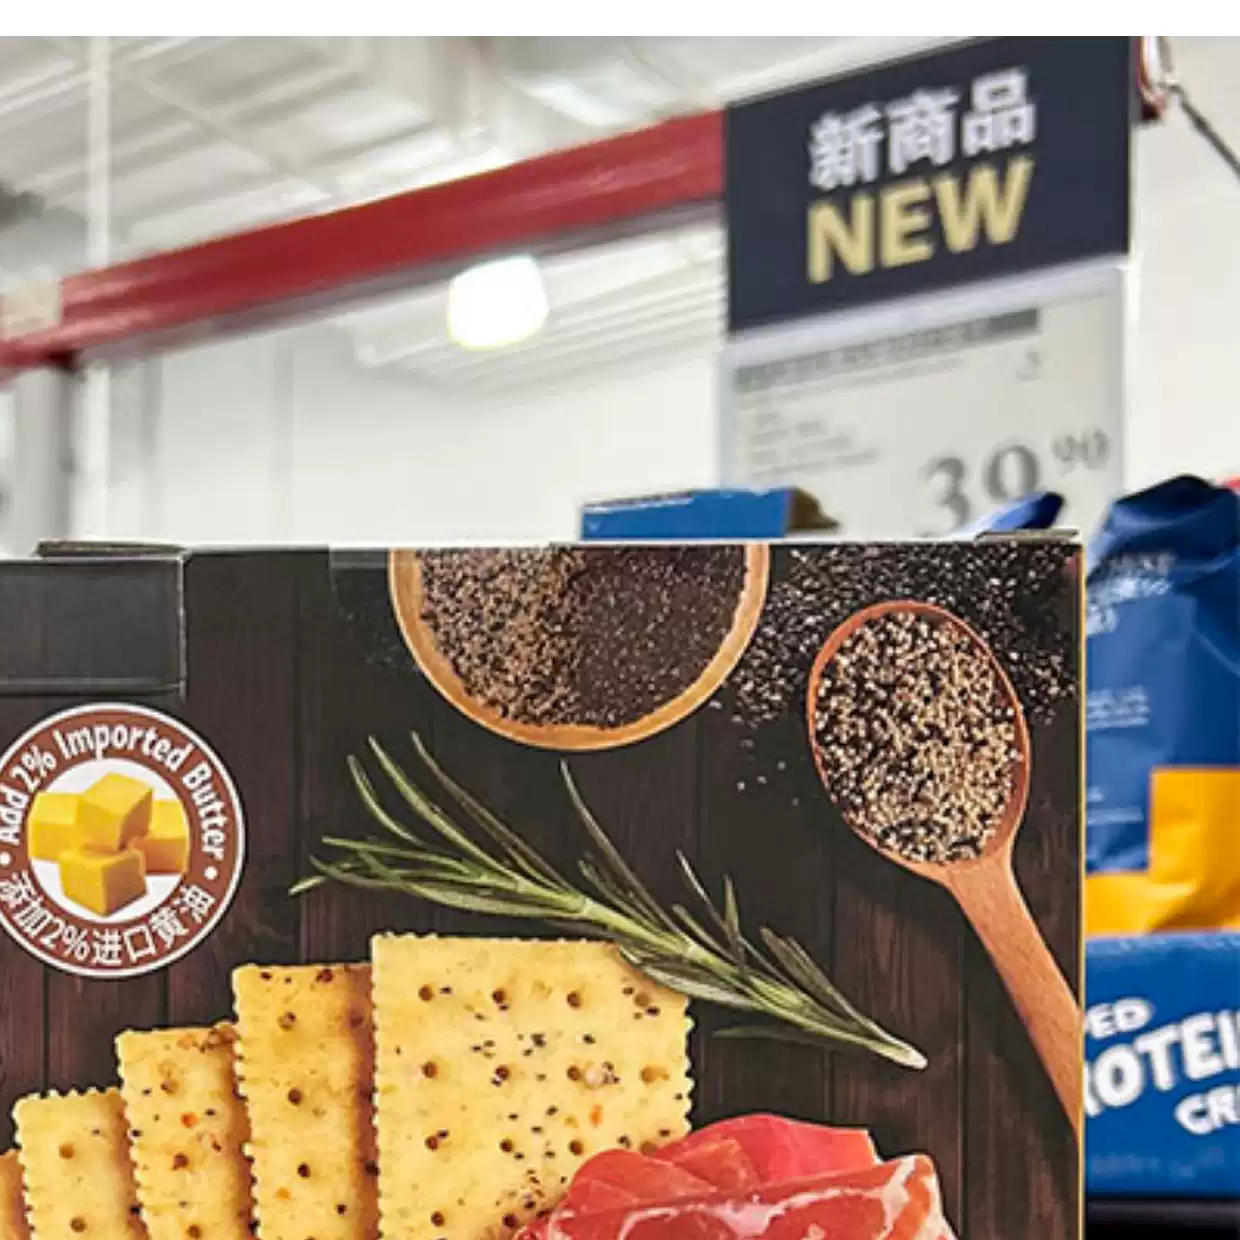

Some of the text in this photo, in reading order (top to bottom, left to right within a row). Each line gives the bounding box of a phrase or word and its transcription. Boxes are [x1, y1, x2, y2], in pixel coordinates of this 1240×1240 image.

[808, 67, 1036, 190] 新商品
[807, 155, 1035, 285] NEW
[10, 745, 57, 792] 2%
[52, 723, 195, 772] Imported
[181, 761, 228, 861] Butter
[1085, 996, 1153, 1041] ED
